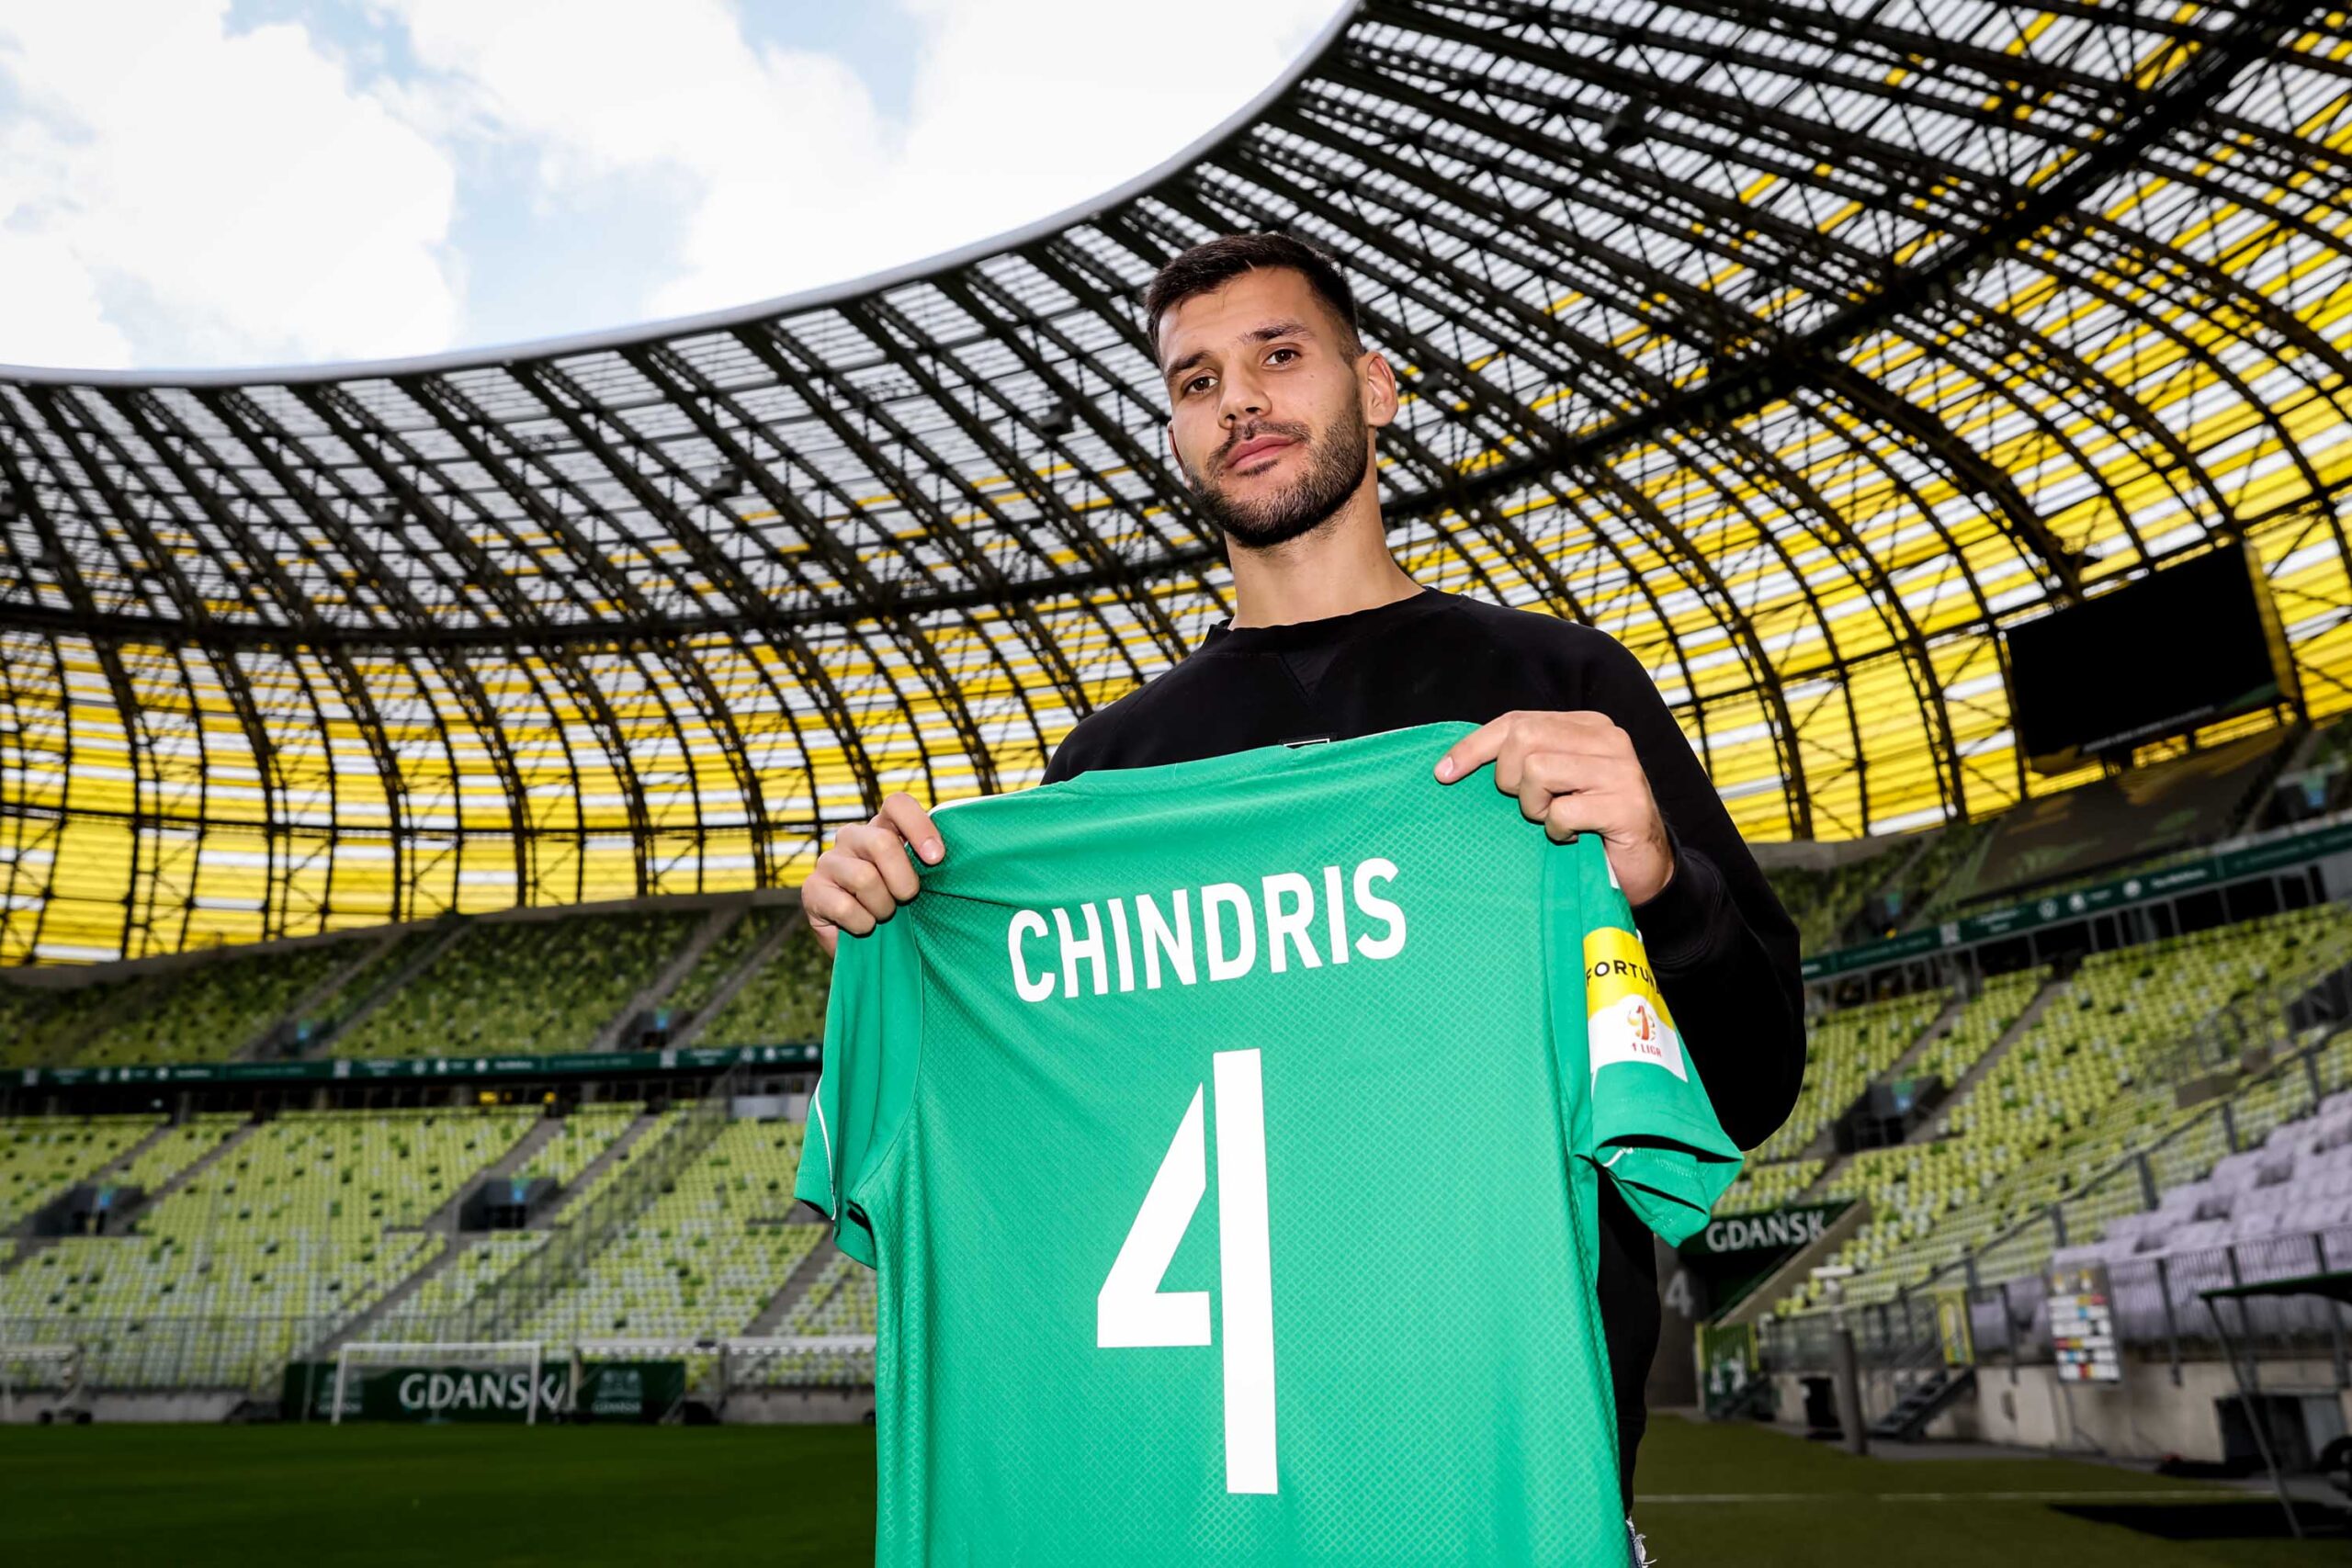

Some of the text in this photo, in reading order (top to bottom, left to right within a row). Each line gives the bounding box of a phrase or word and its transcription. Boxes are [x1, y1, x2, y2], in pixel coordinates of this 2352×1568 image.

[1008, 857, 1407, 1003] CHINDRIS
[1097, 1047, 1278, 1495] 4
[1706, 1209, 1826, 1253] GDAŃSK
[1665, 1269, 1694, 1318] 4
